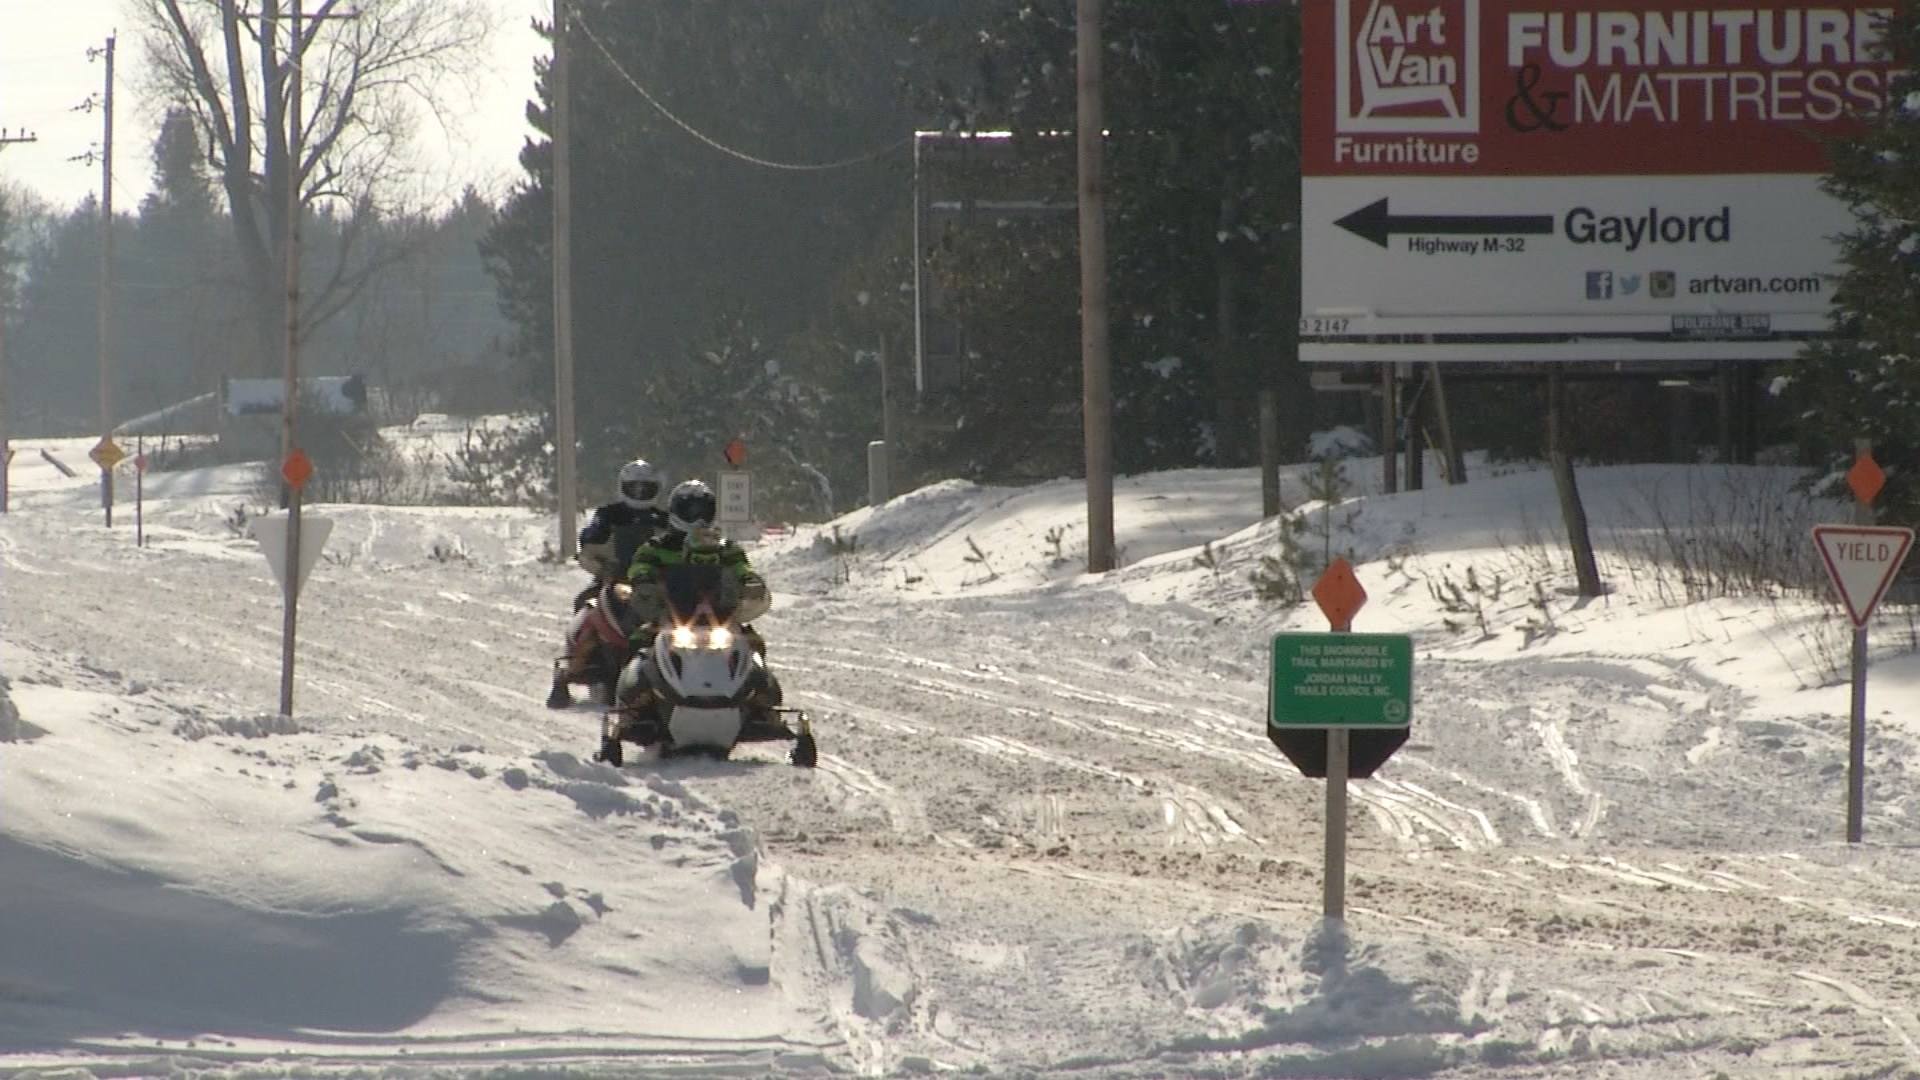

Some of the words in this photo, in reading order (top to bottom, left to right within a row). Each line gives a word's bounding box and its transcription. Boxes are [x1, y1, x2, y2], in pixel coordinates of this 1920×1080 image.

[1369, 4, 1446, 44] Art
[1507, 8, 1895, 67] FURNITURE
[1369, 46, 1457, 85] Van
[1506, 65, 1569, 133] &
[1334, 136, 1480, 163] Furniture
[1564, 206, 1731, 252] Gaylord
[1408, 237, 1479, 256] Highway
[1483, 237, 1525, 253] M-32
[1689, 274, 1821, 295] artvan.com
[1313, 319, 1350, 332] 2147
[1836, 542, 1889, 562] YIELD
[1294, 685, 1327, 696] TRAILS
[1329, 685, 1371, 696] COUNCIL
[1304, 673, 1344, 684] JORDAN
[1345, 673, 1383, 684] VALLEY
